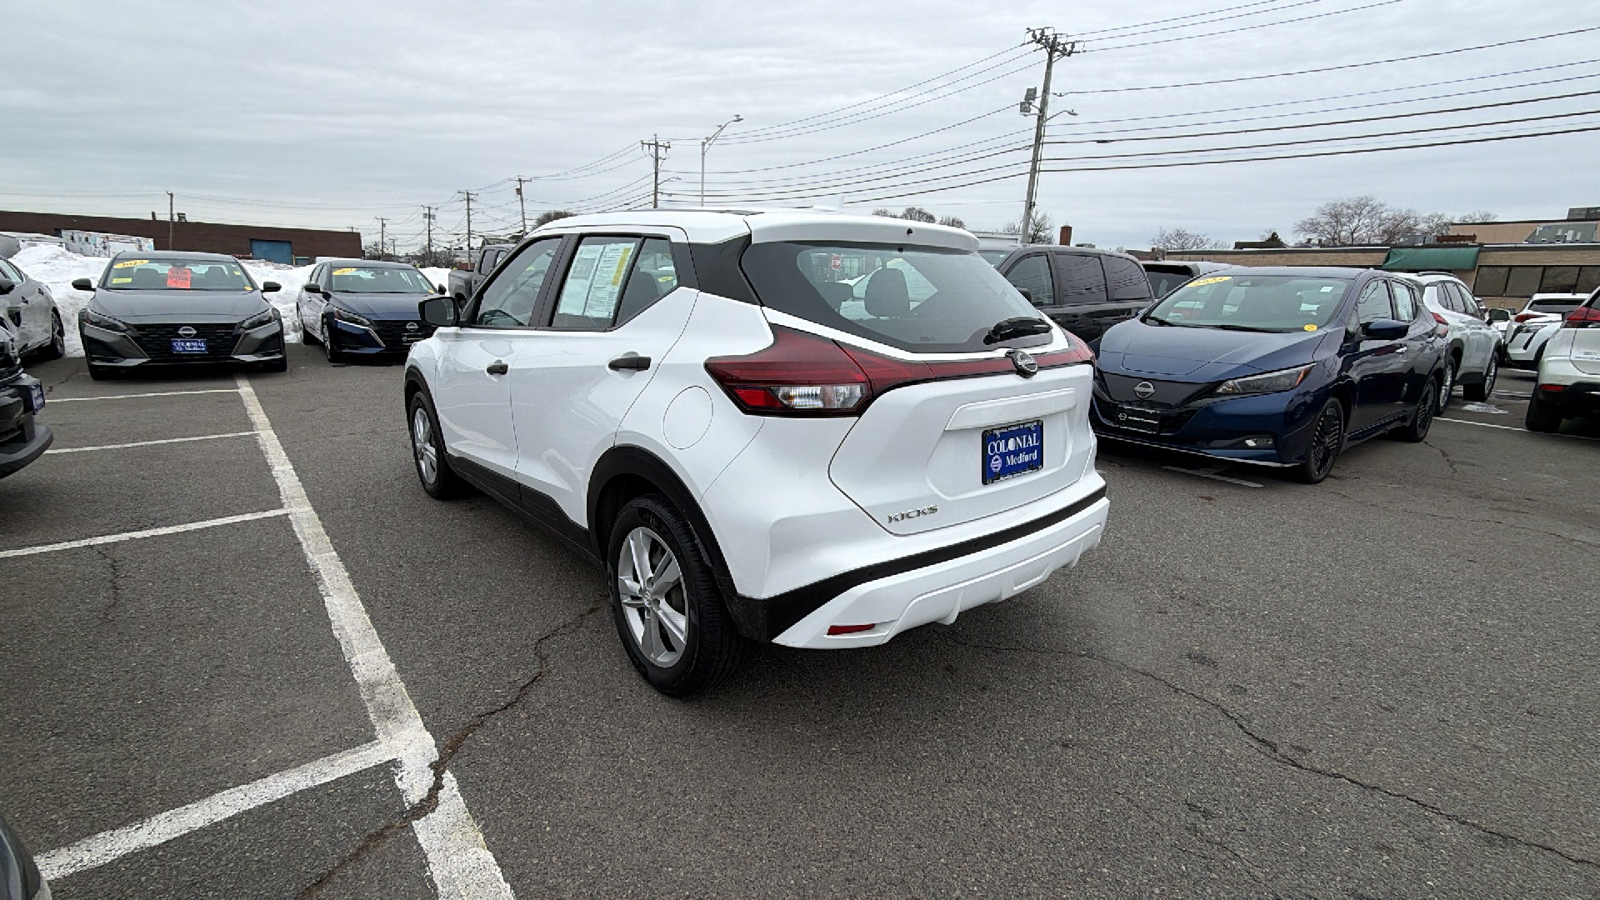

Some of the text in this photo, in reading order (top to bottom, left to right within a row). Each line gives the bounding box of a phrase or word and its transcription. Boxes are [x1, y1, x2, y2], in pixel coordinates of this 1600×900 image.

[987, 432, 1040, 456] COLONIAL
[1005, 449, 1038, 467] Medford
[887, 504, 938, 524] KICKS
